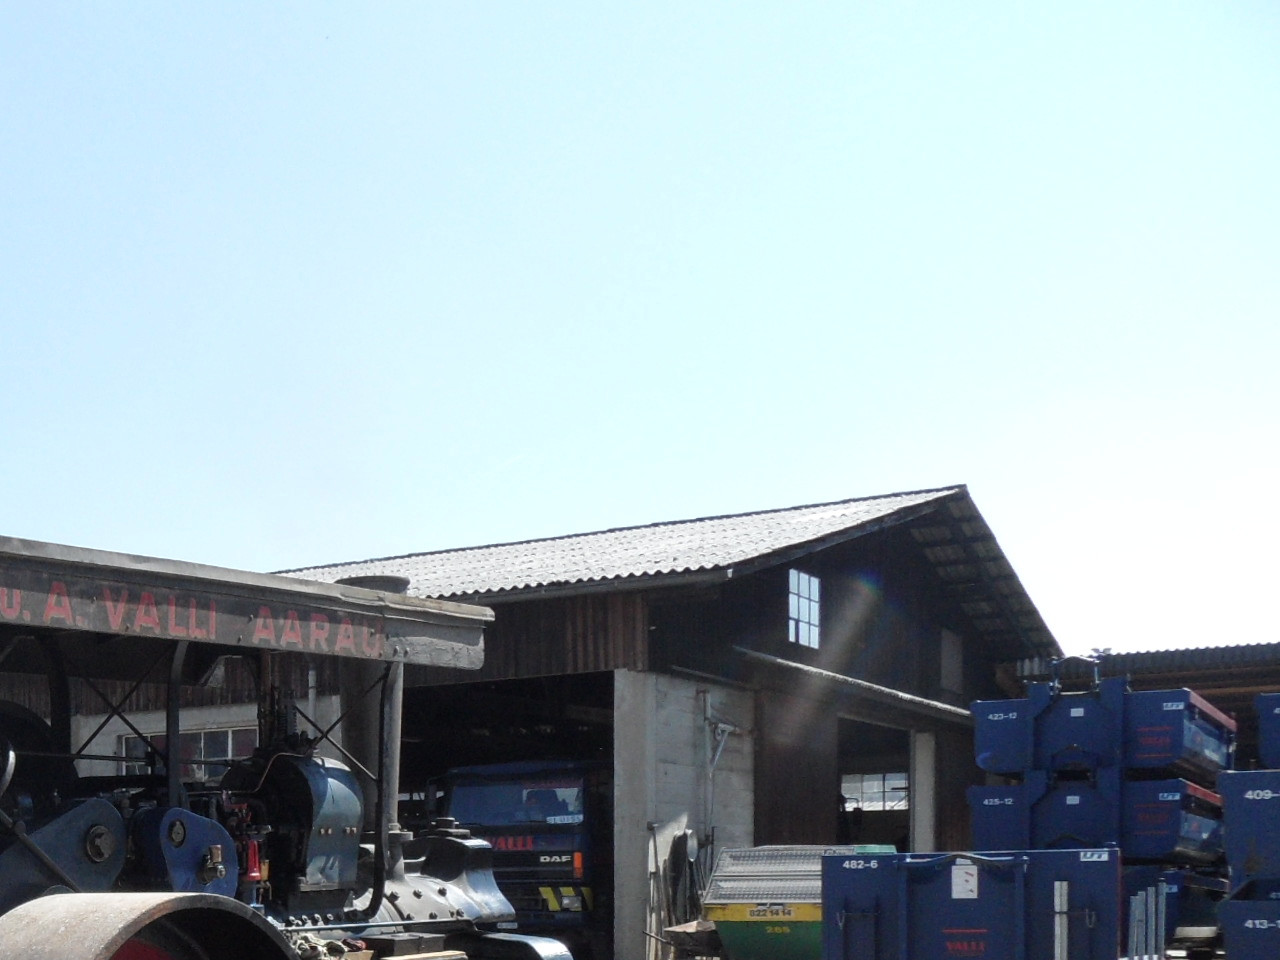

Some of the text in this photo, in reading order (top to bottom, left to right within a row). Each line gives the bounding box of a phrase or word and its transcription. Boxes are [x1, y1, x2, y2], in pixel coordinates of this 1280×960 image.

[102, 586, 216, 640] VALLI
[252, 604, 386, 659] AARAU
[539, 855, 572, 863] DAF
[842, 860, 879, 870] 482-6
